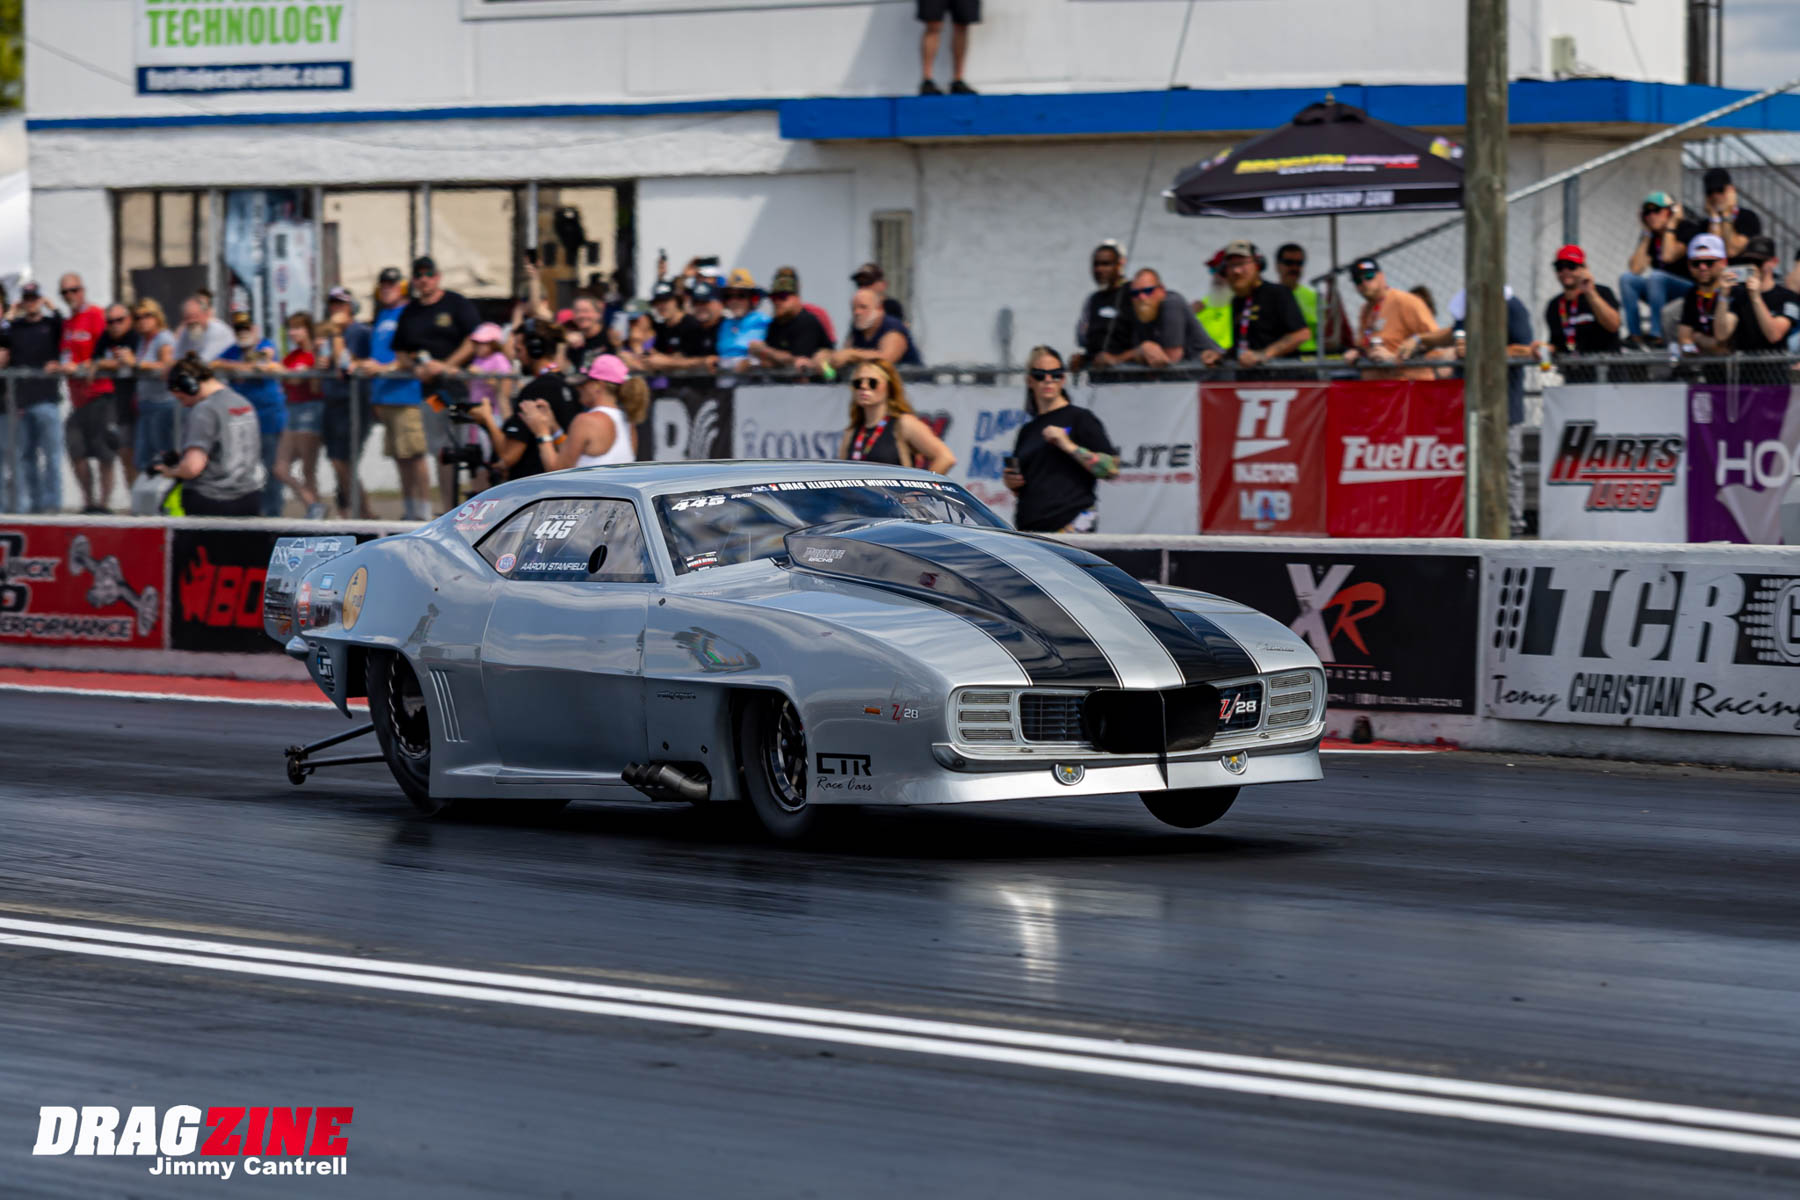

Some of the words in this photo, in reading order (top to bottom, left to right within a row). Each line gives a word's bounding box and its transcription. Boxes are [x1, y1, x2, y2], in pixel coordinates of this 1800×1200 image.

[146, 4, 344, 48] TECHNOLOGY
[1235, 389, 1298, 439] FT
[1341, 436, 1466, 470] FuelTec
[1549, 420, 1685, 486] HARTS
[1716, 439, 1800, 488] HO
[778, 482, 807, 491] DRAG
[807, 479, 865, 490] ILLUSTRATED
[865, 479, 901, 488] WINTER
[900, 480, 934, 490] SERIES
[1584, 483, 1664, 512] TURBO
[453, 499, 499, 524] ST
[671, 494, 726, 512] 445
[533, 519, 578, 540] 445
[520, 562, 549, 571] AARON
[550, 561, 588, 571] STANFIELD
[0, 615, 132, 641] ERFORMANCE
[1548, 566, 1747, 664] TCR
[1491, 674, 1563, 717] Tony
[1568, 672, 1686, 717] CHRISTIAN
[816, 752, 872, 776] CTR
[816, 776, 843, 793] Race
[848, 777, 873, 792] Cars
